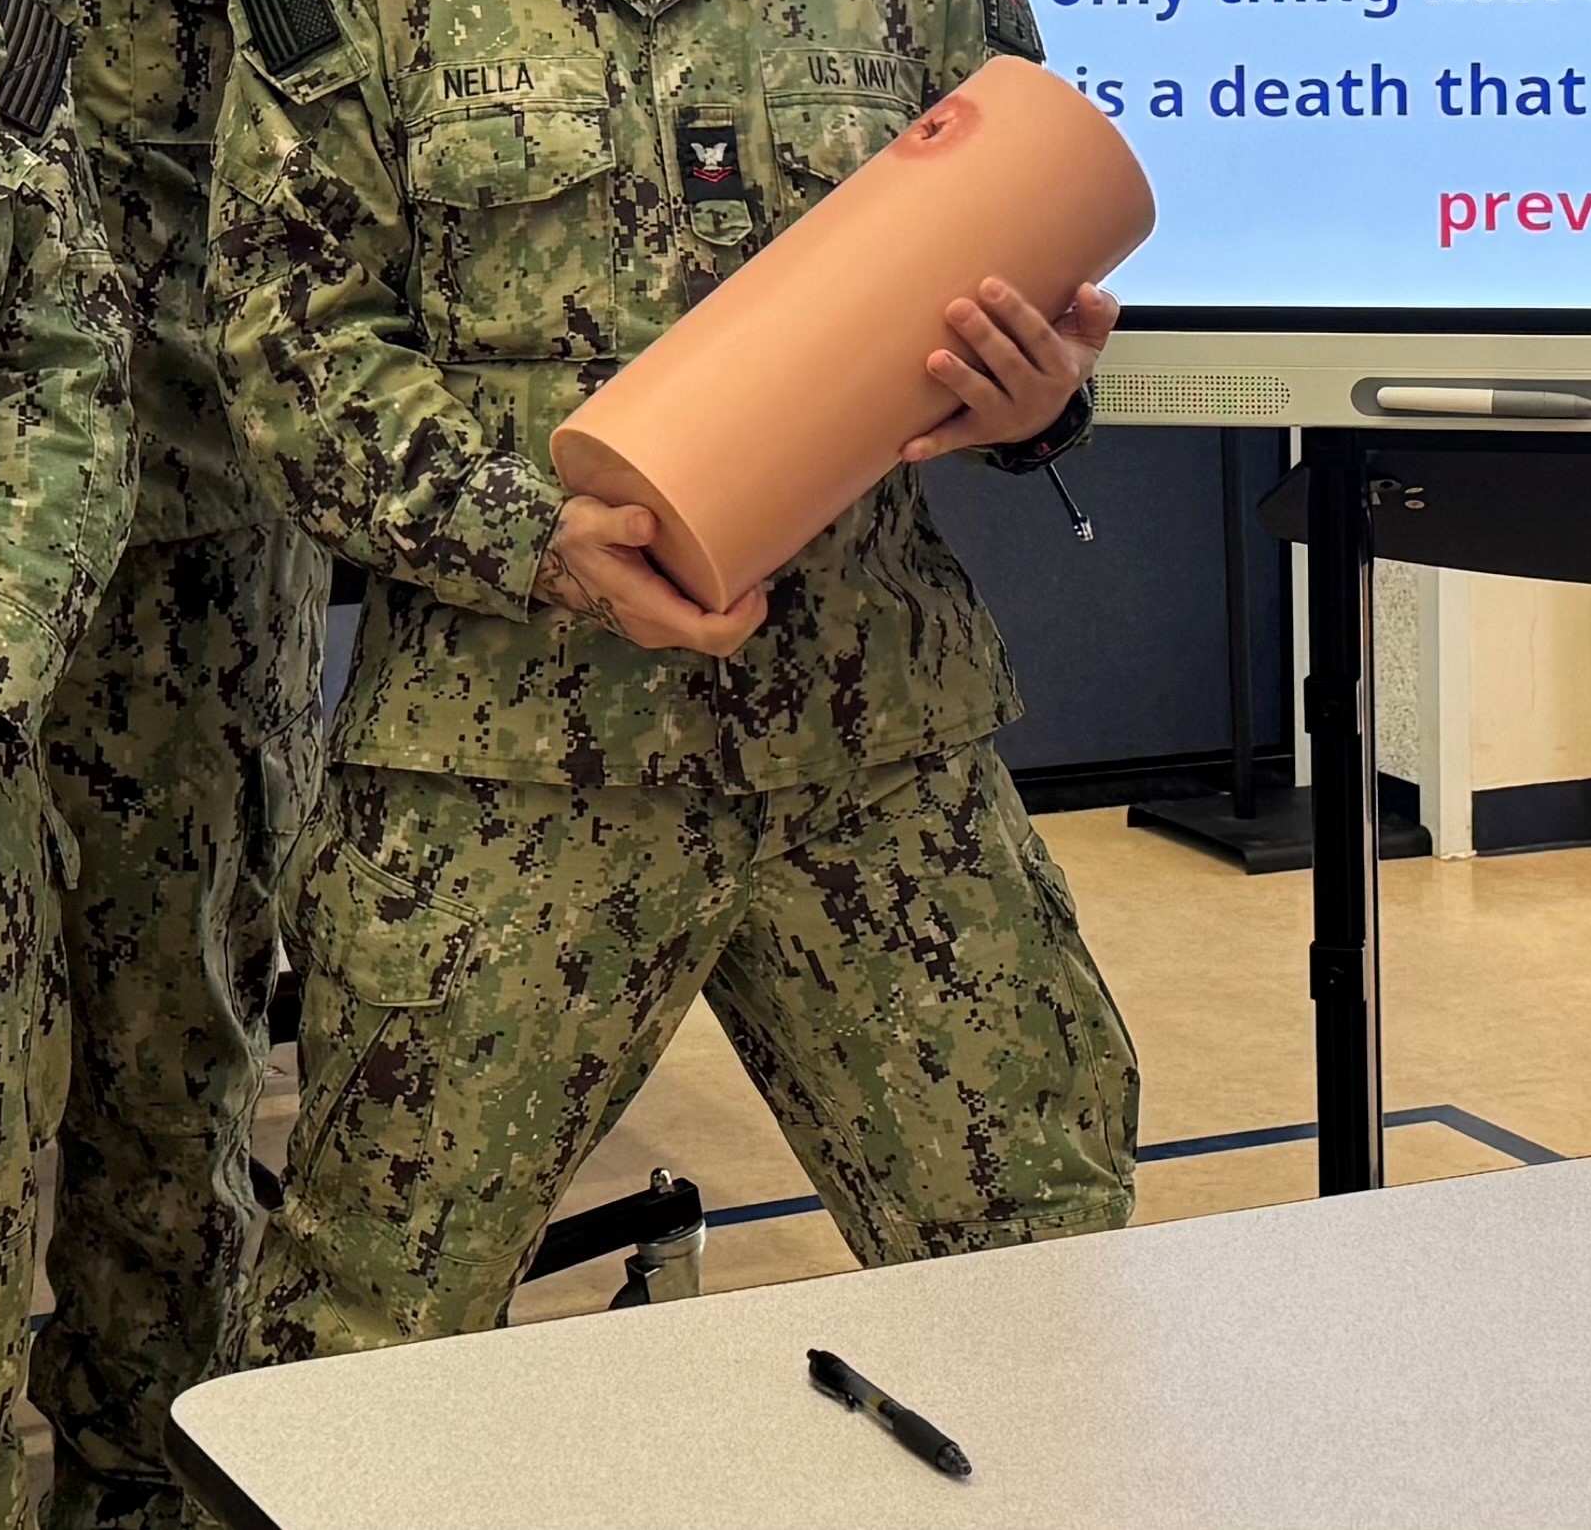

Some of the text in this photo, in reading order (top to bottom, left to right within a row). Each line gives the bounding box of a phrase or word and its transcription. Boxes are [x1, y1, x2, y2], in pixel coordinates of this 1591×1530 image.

[443, 62, 535, 100] NELLA
[808, 56, 897, 94] U.S. NAVY
[1149, 78, 1184, 118] a
[1208, 63, 1409, 118] death
[1434, 61, 1588, 116] that
